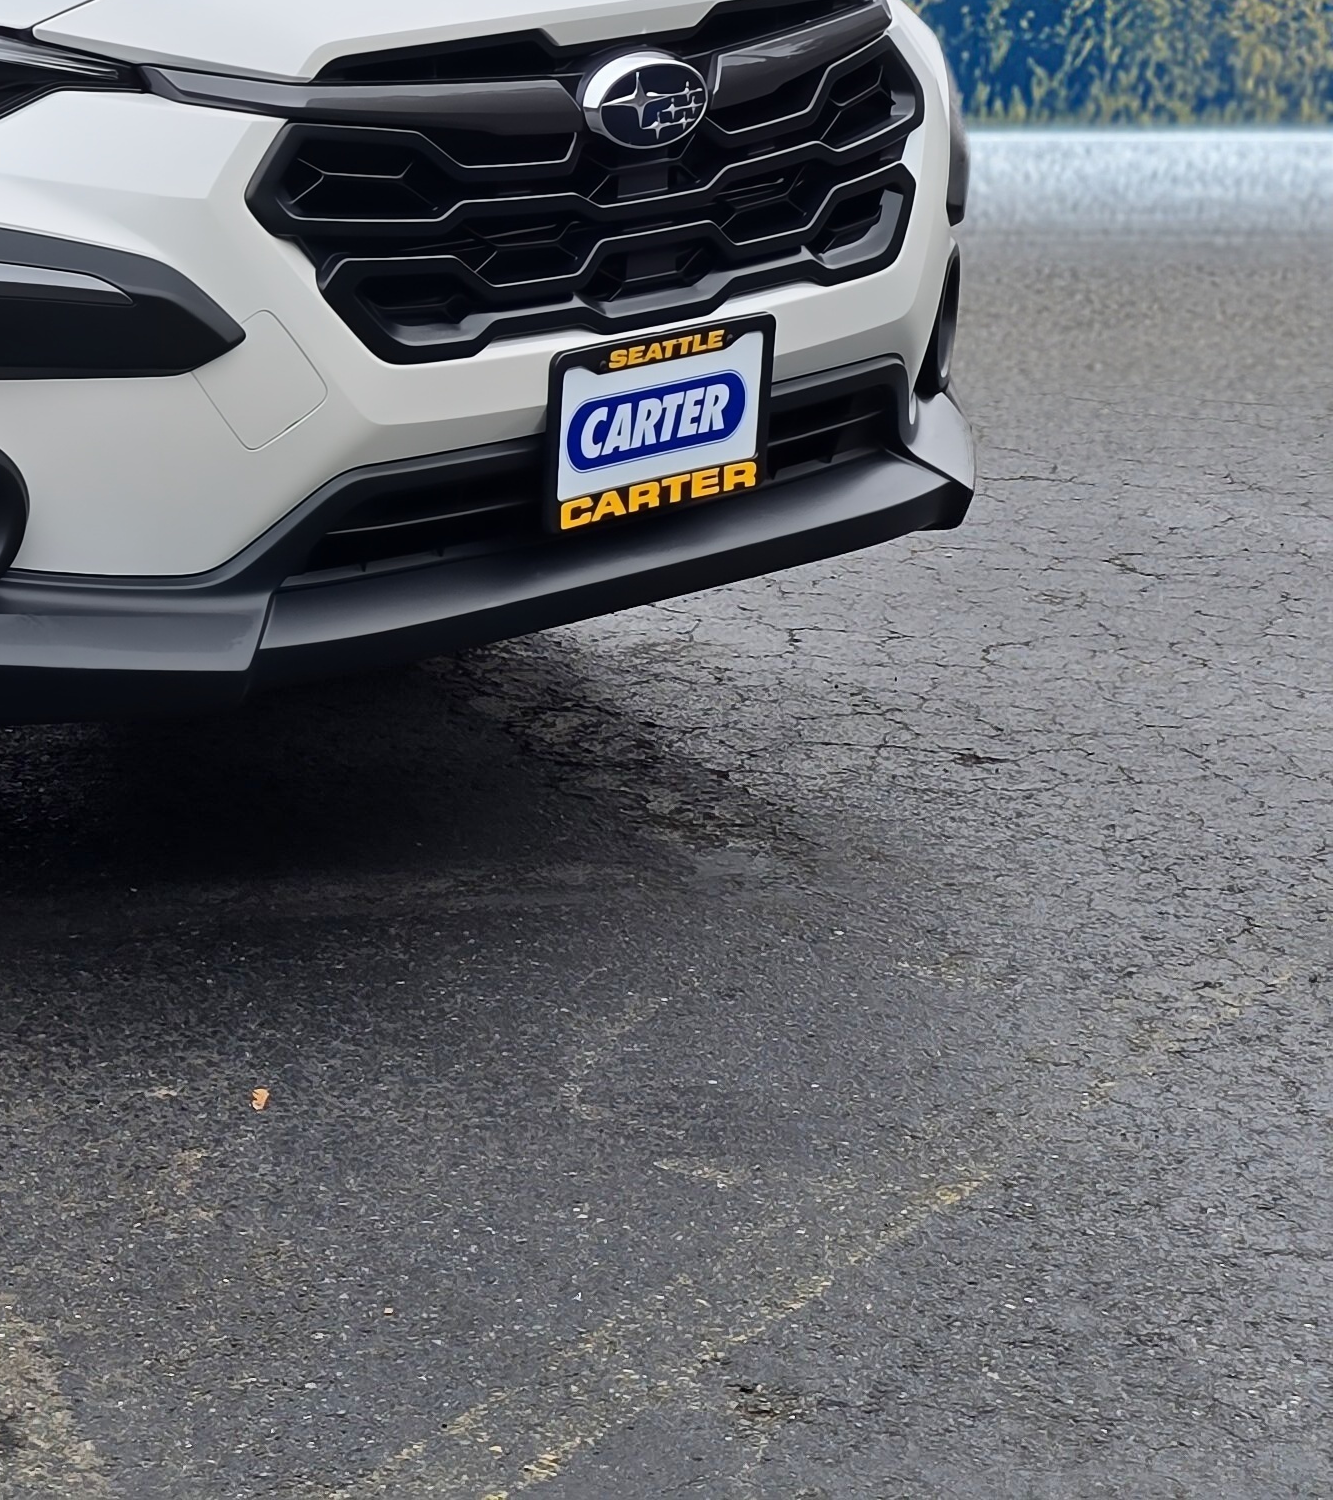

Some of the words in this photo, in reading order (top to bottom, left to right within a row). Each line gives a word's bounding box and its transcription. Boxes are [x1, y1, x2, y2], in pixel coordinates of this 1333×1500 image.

[608, 329, 725, 369] SEATTLE
[580, 383, 730, 459] CARTER
[560, 461, 757, 530] CARTER
